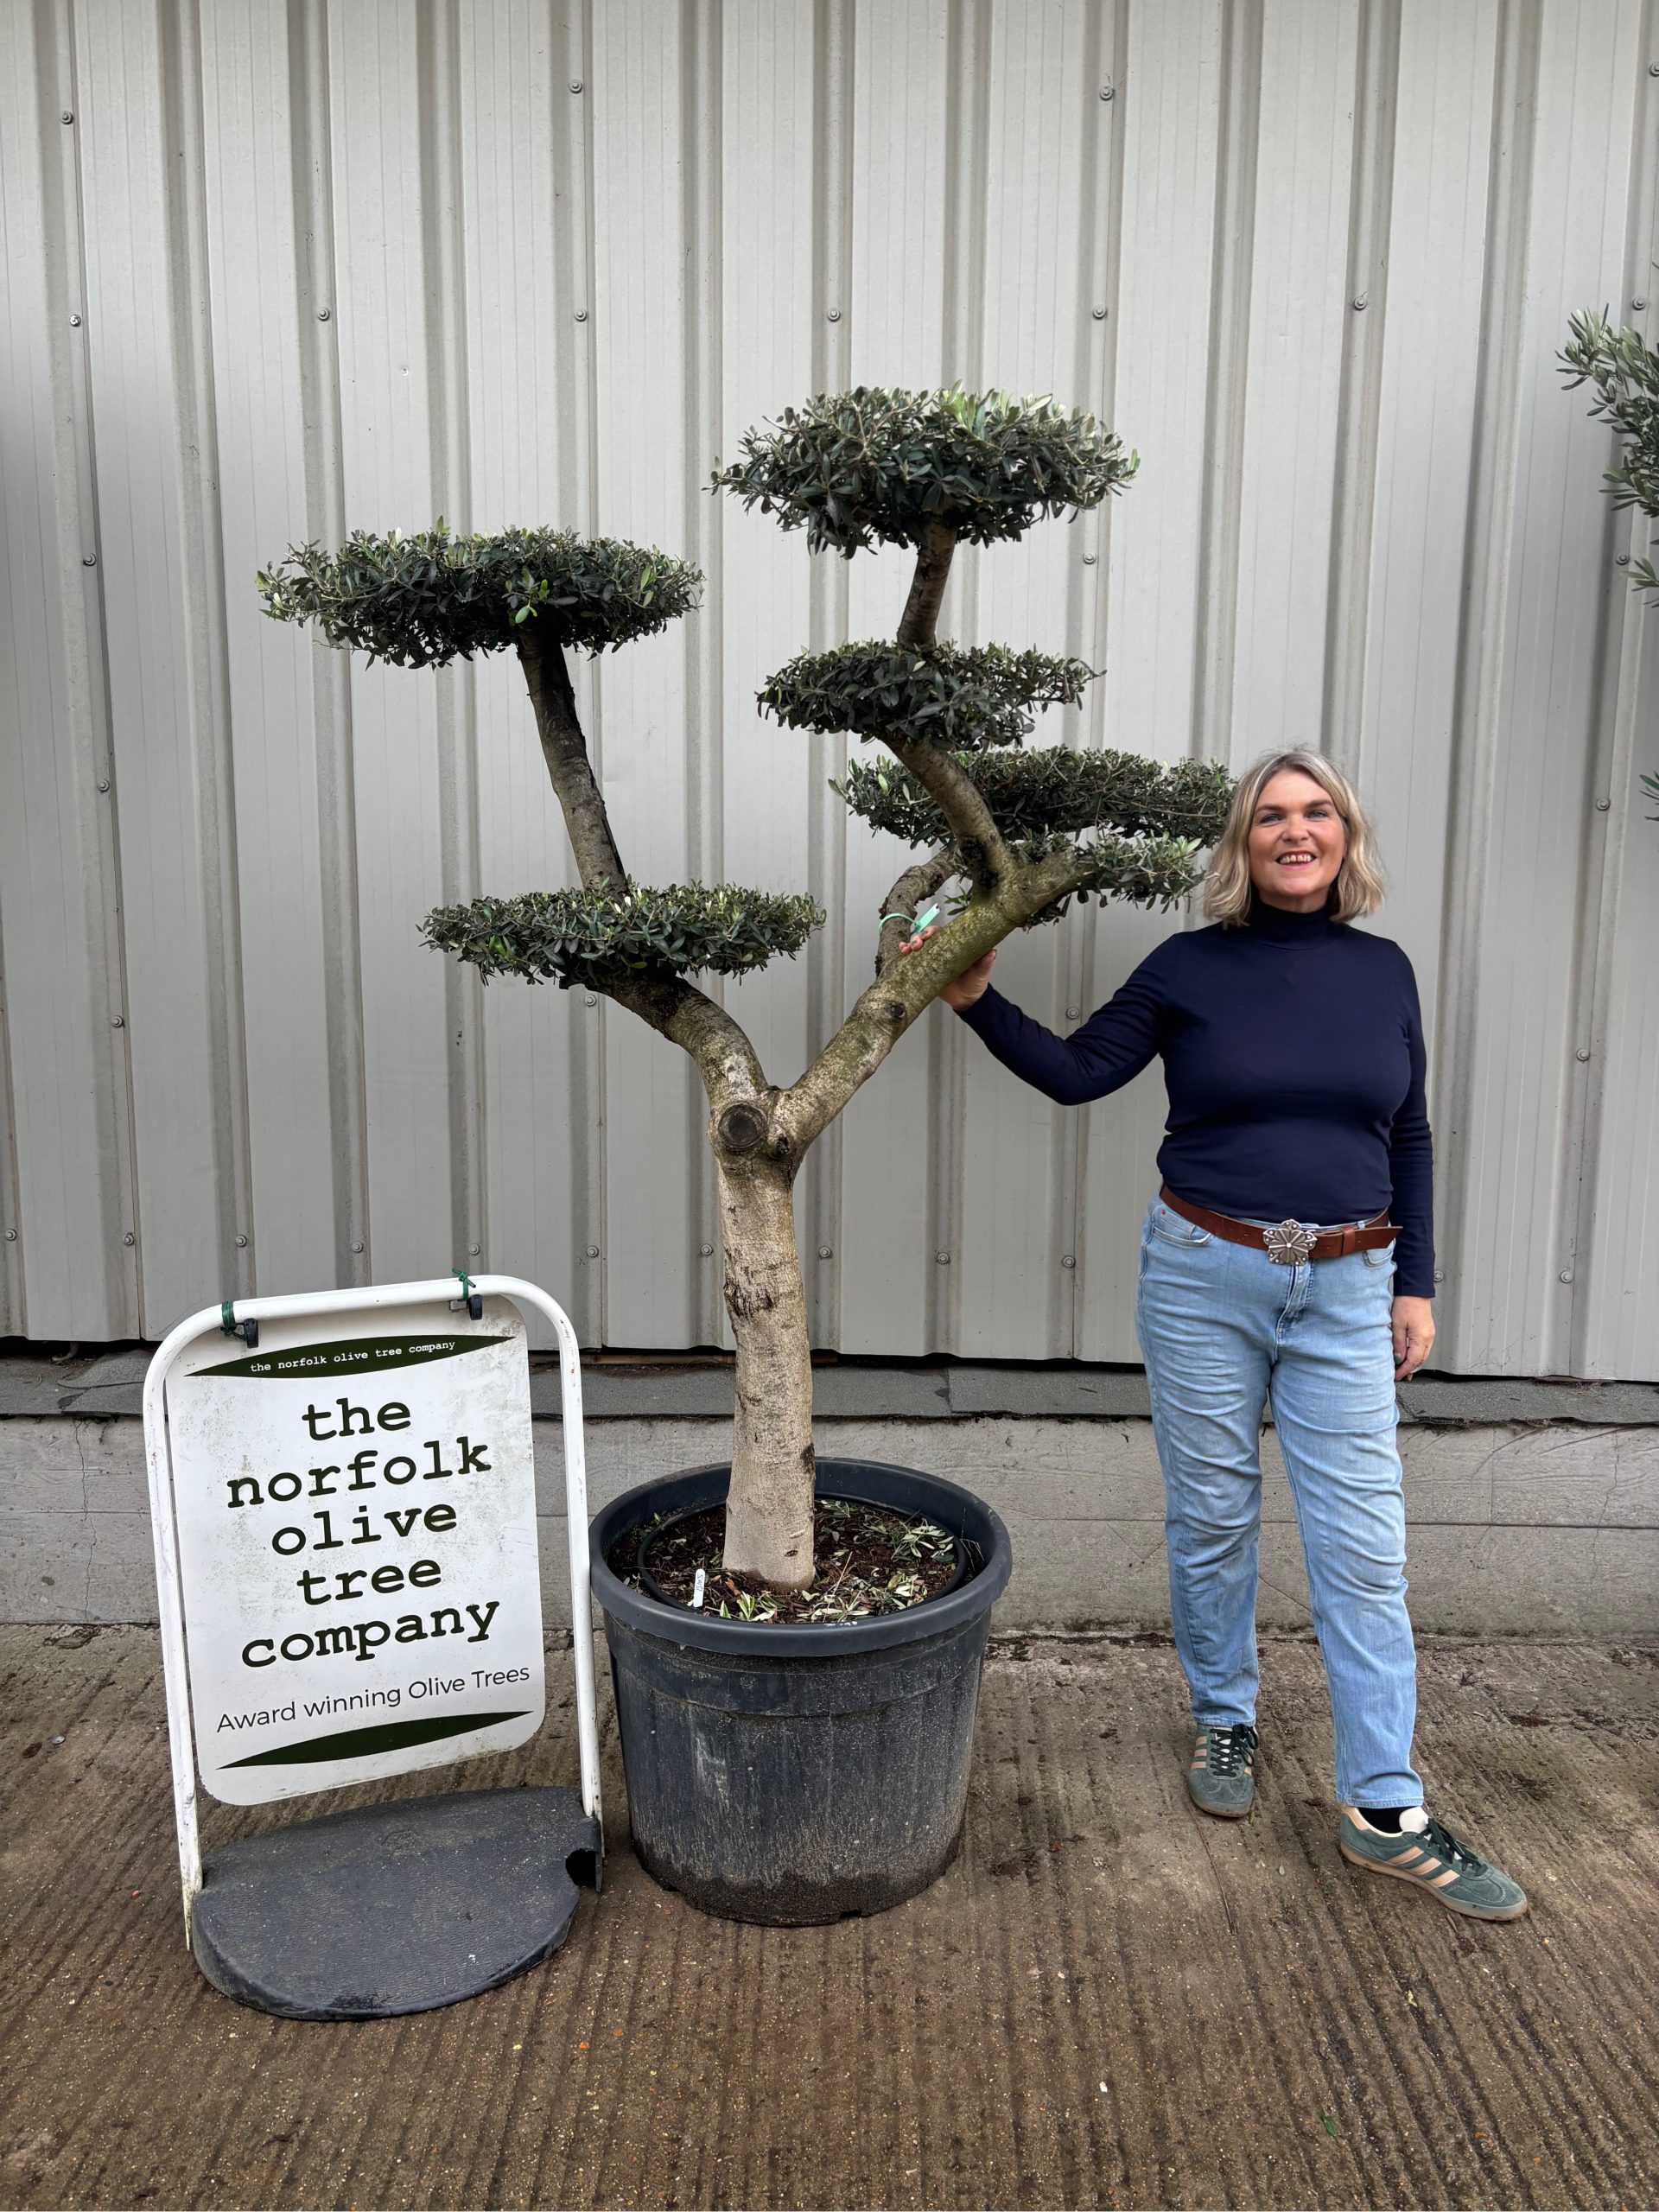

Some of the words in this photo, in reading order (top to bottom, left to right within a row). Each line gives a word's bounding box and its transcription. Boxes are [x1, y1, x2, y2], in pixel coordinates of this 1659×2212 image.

[250, 1363, 271, 1372] the
[277, 1355, 327, 1370] norfolk
[334, 1351, 369, 1363] olive
[375, 1348, 403, 1357] tree
[408, 1341, 455, 1354] company
[302, 1397, 411, 1441] the
[226, 1436, 492, 1509] norfolk
[271, 1503, 457, 1556] olive
[296, 1559, 442, 1605] tree
[241, 1600, 500, 1668] company
[216, 1700, 296, 1733] Award
[303, 1688, 401, 1718] winning
[408, 1677, 466, 1700] Olive
[471, 1667, 530, 1688] Trees
